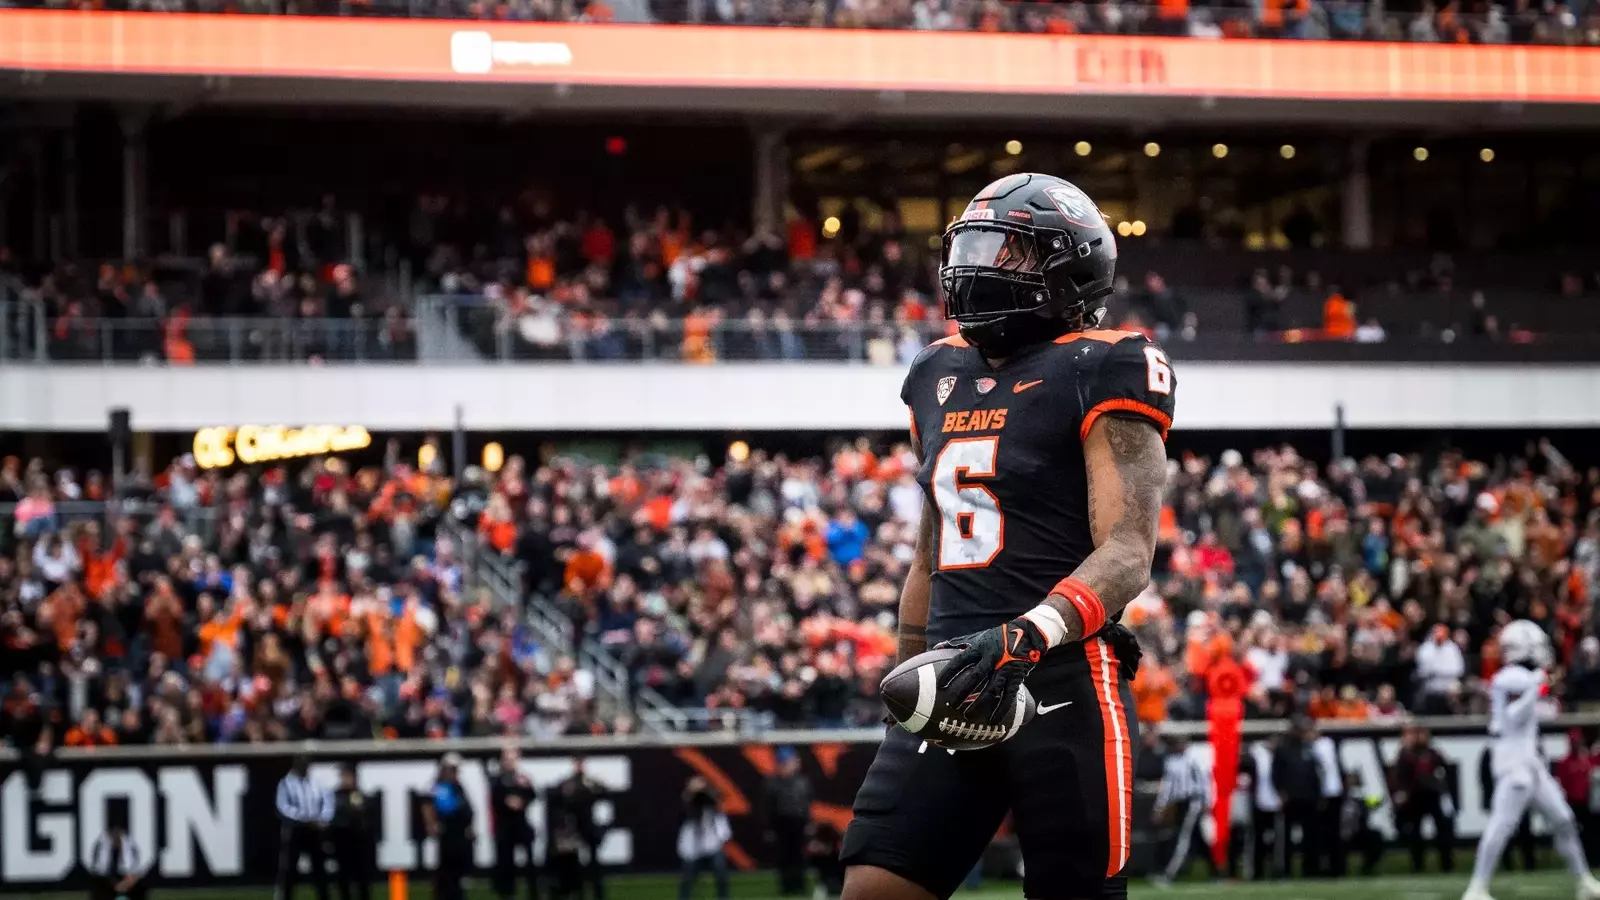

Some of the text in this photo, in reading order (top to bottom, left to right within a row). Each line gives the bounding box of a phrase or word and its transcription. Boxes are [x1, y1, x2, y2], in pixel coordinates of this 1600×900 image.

[1143, 345, 1171, 396] 6
[942, 408, 1008, 432] BEAVS
[931, 436, 1005, 570] 6
[2, 763, 249, 882] GON
